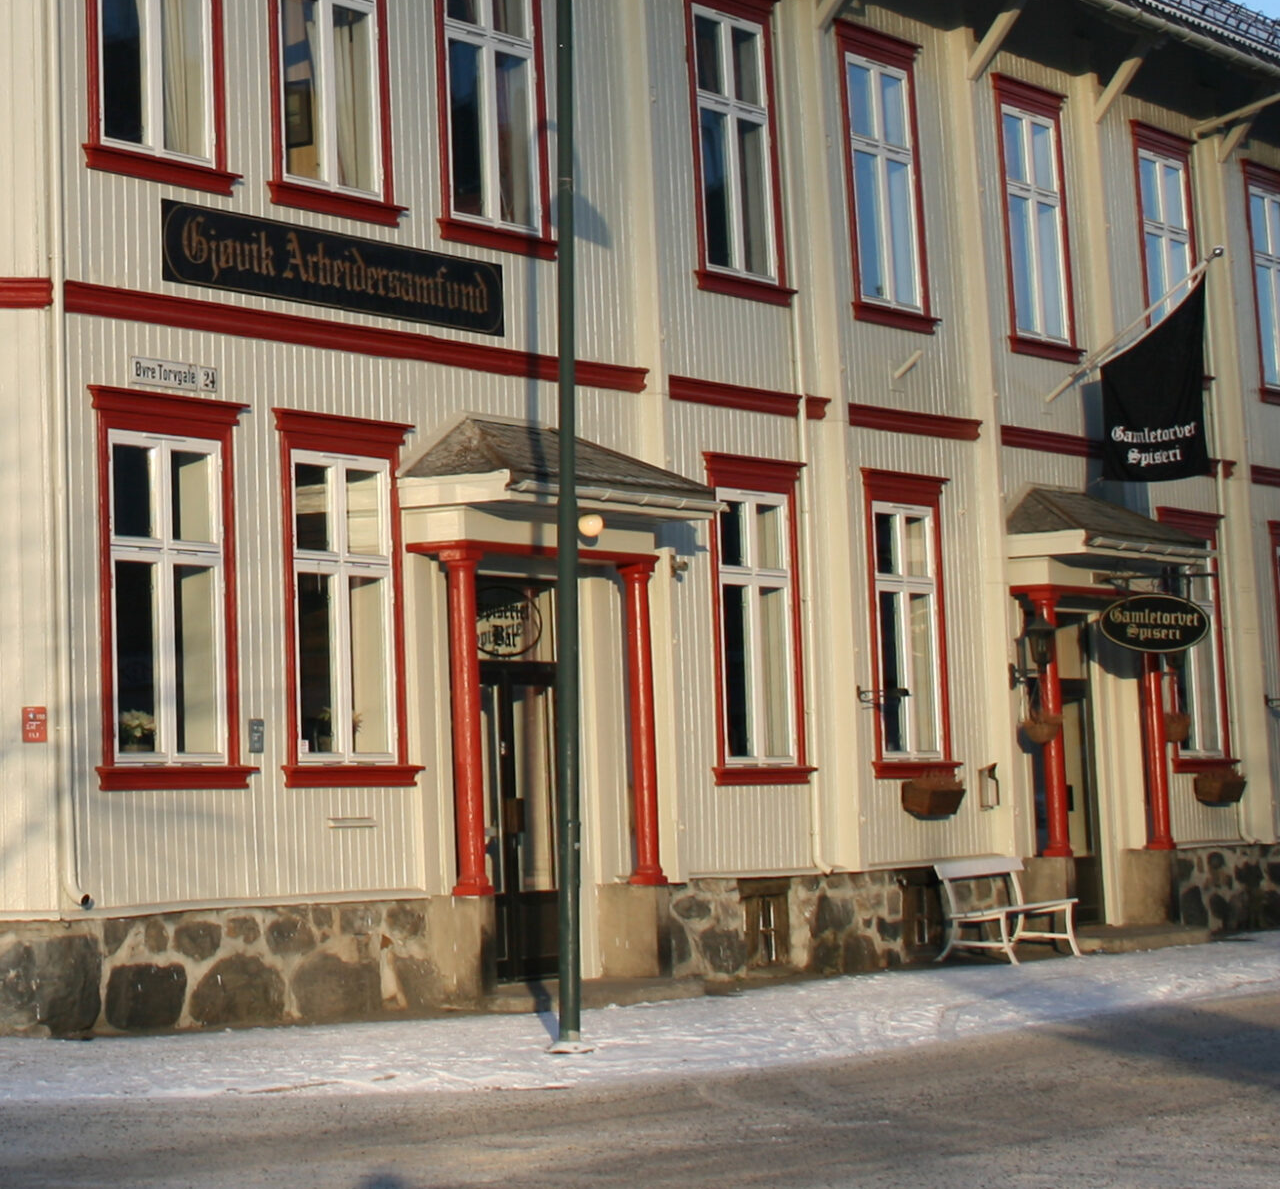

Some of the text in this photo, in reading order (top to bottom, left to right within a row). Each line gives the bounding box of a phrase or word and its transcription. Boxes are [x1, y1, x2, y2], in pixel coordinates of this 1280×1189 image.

[181, 215, 489, 314] Gjøvik Arbeidersamfund
[135, 361, 195, 386] Øvre Torvgate
[203, 371, 216, 389] 24
[1111, 421, 1197, 443] Gamletorvet
[1127, 445, 1181, 467] Spiseri
[1109, 608, 1200, 626] Gamletorvet
[1126, 624, 1181, 641] Spiseri
